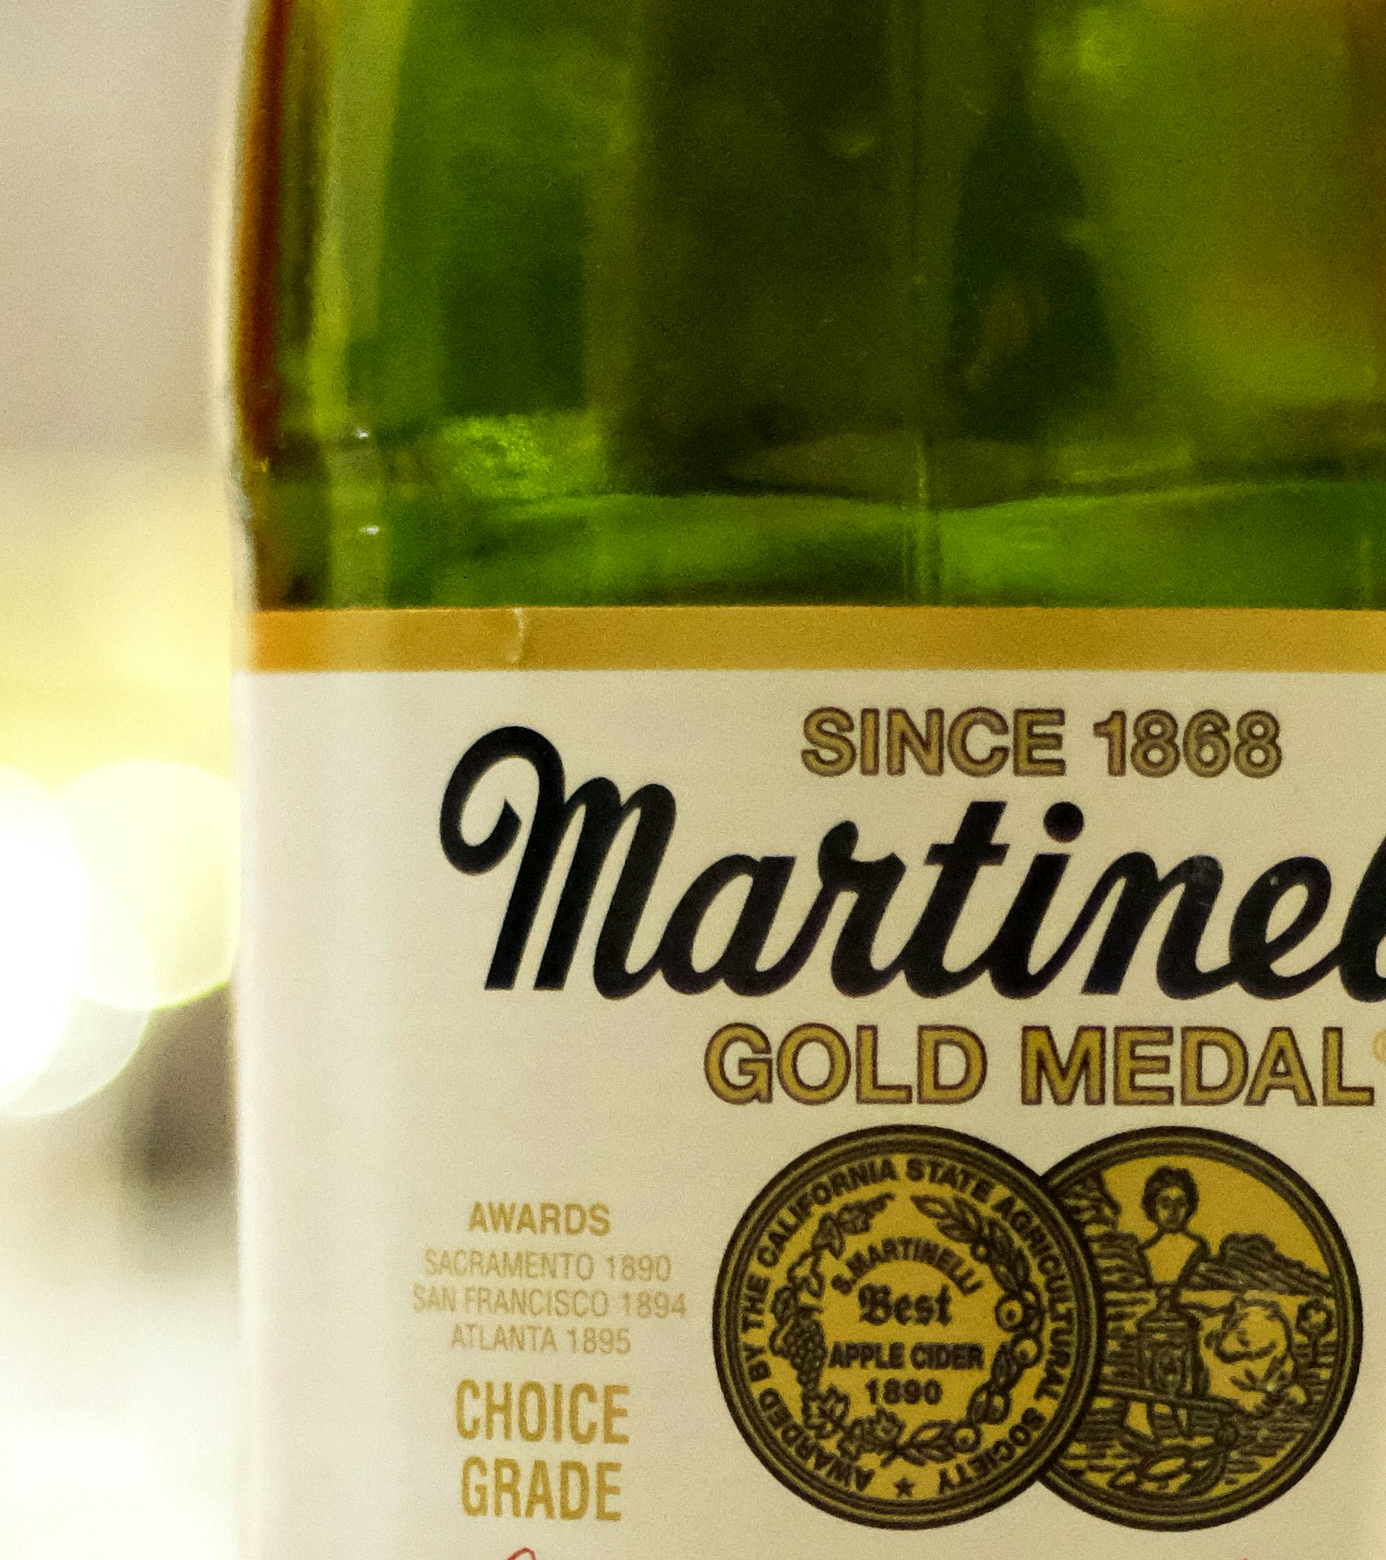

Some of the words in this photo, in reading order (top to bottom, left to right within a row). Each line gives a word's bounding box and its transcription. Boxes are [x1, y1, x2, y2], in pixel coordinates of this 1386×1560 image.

[800, 706, 1067, 778] SINCE
[1092, 707, 1283, 778] 1868
[703, 1021, 989, 1107] GOLD
[1020, 1024, 1377, 1108] MEDAL
[905, 1156, 996, 1204] STATE
[468, 1200, 613, 1238] AWARDS
[756, 1157, 901, 1269] CALIFORNIA
[424, 1247, 596, 1283] SACRAMENTO
[606, 1252, 673, 1284] 1890
[413, 1282, 458, 1314] SAN
[465, 1284, 610, 1319] FRANCISCO
[621, 1289, 688, 1320] 1894
[740, 1272, 771, 1334] THE
[858, 1282, 954, 1327] Best
[989, 1194, 1078, 1402] AGRICULTURAL
[450, 1321, 558, 1353] ATLANTA
[566, 1326, 632, 1355] 1895
[742, 1342, 773, 1383] BY
[828, 1340, 906, 1371] APPLE
[909, 1340, 986, 1371] CIDER
[455, 1378, 631, 1446] CHOICE
[758, 1386, 877, 1493] AWARDED
[937, 1406, 1048, 1496] SOCIETY
[462, 1455, 623, 1523] GRADE
